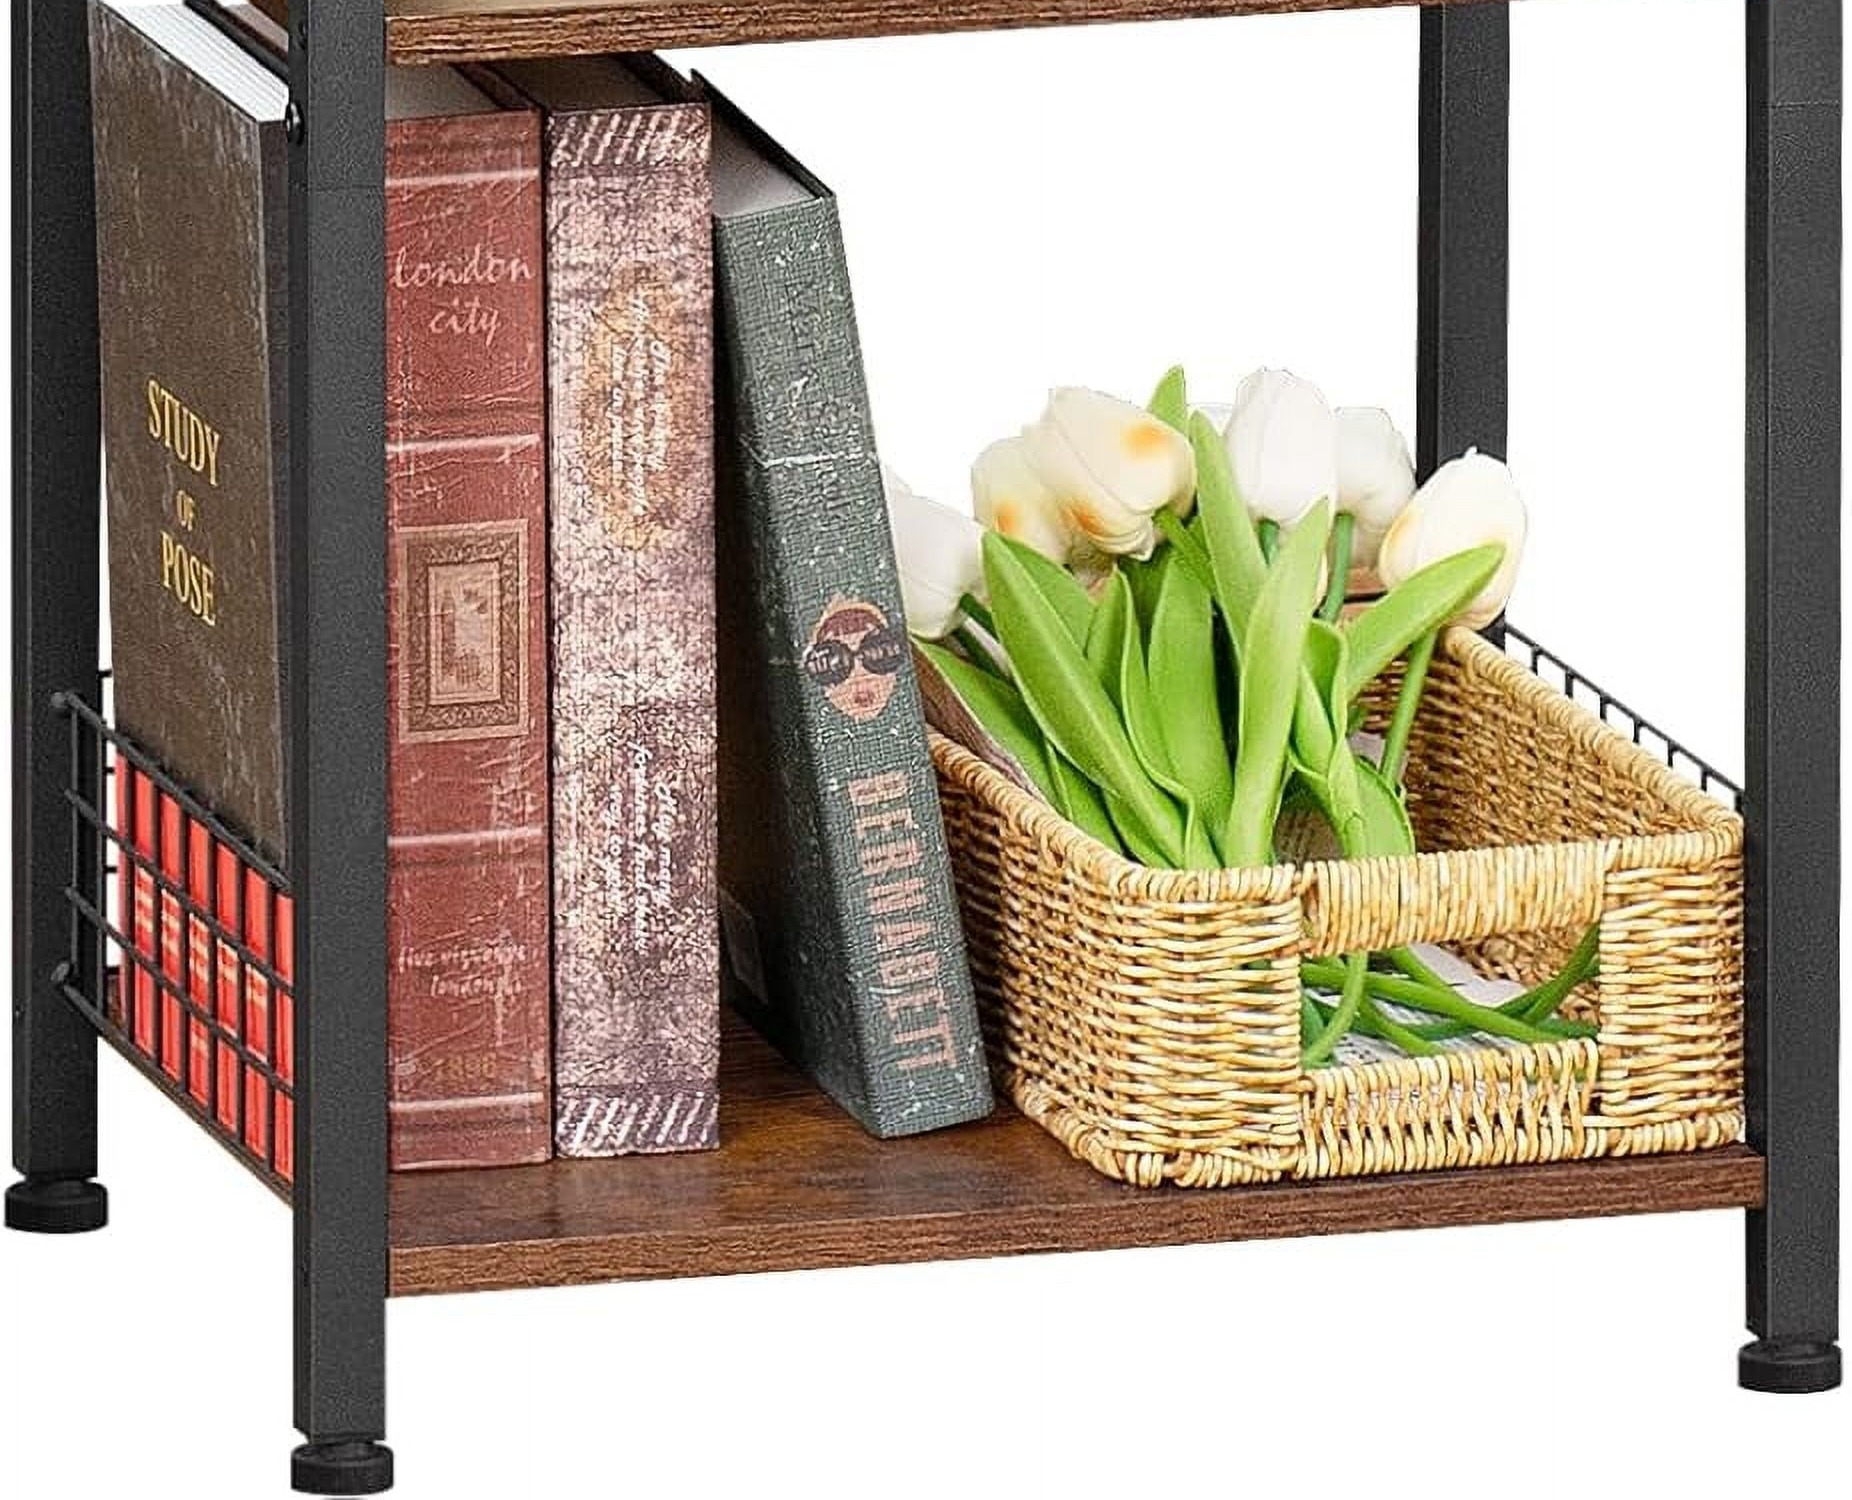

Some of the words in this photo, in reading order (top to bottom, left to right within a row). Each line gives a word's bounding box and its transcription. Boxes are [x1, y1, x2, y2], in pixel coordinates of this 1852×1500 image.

[428, 295, 501, 346] city
[147, 378, 221, 488] STUDY
[159, 530, 217, 627] POSE
